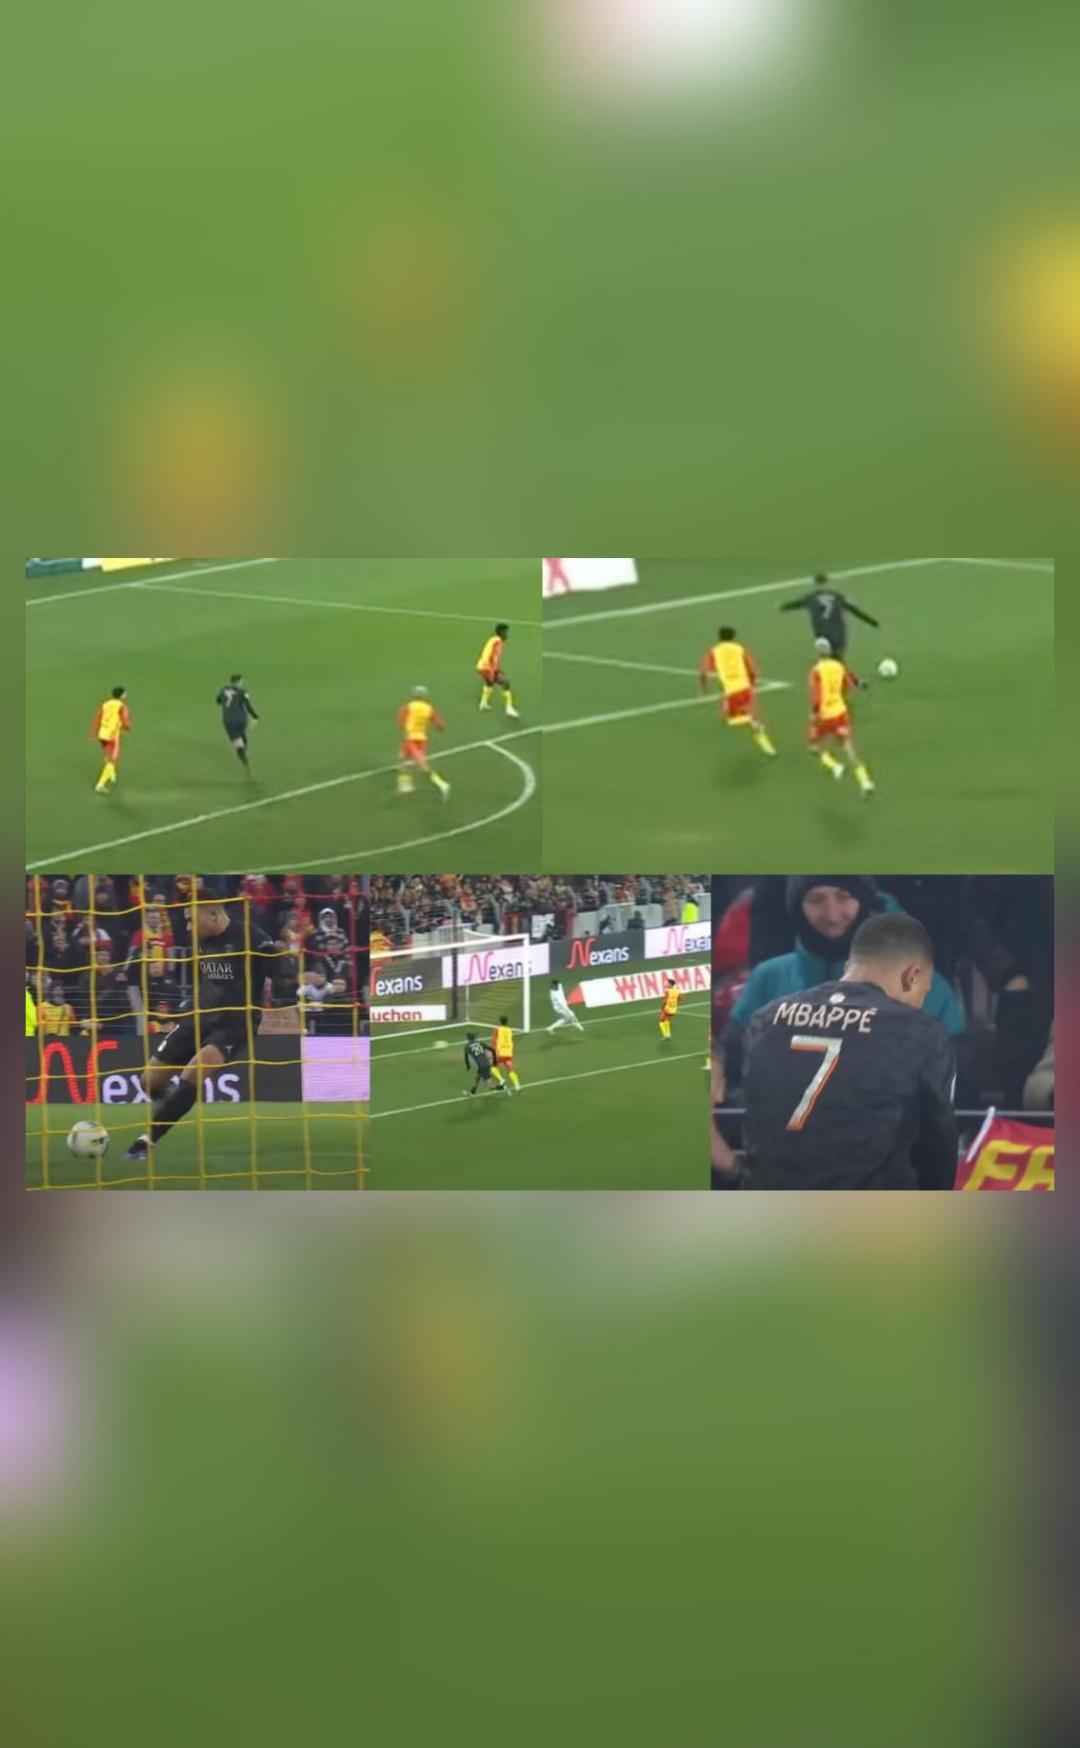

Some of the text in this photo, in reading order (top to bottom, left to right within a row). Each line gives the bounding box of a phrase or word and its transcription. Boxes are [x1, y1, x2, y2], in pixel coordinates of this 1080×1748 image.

[463, 951, 532, 983] Nexan
[566, 937, 630, 969] Nexans
[785, 1035, 842, 1132] 7
